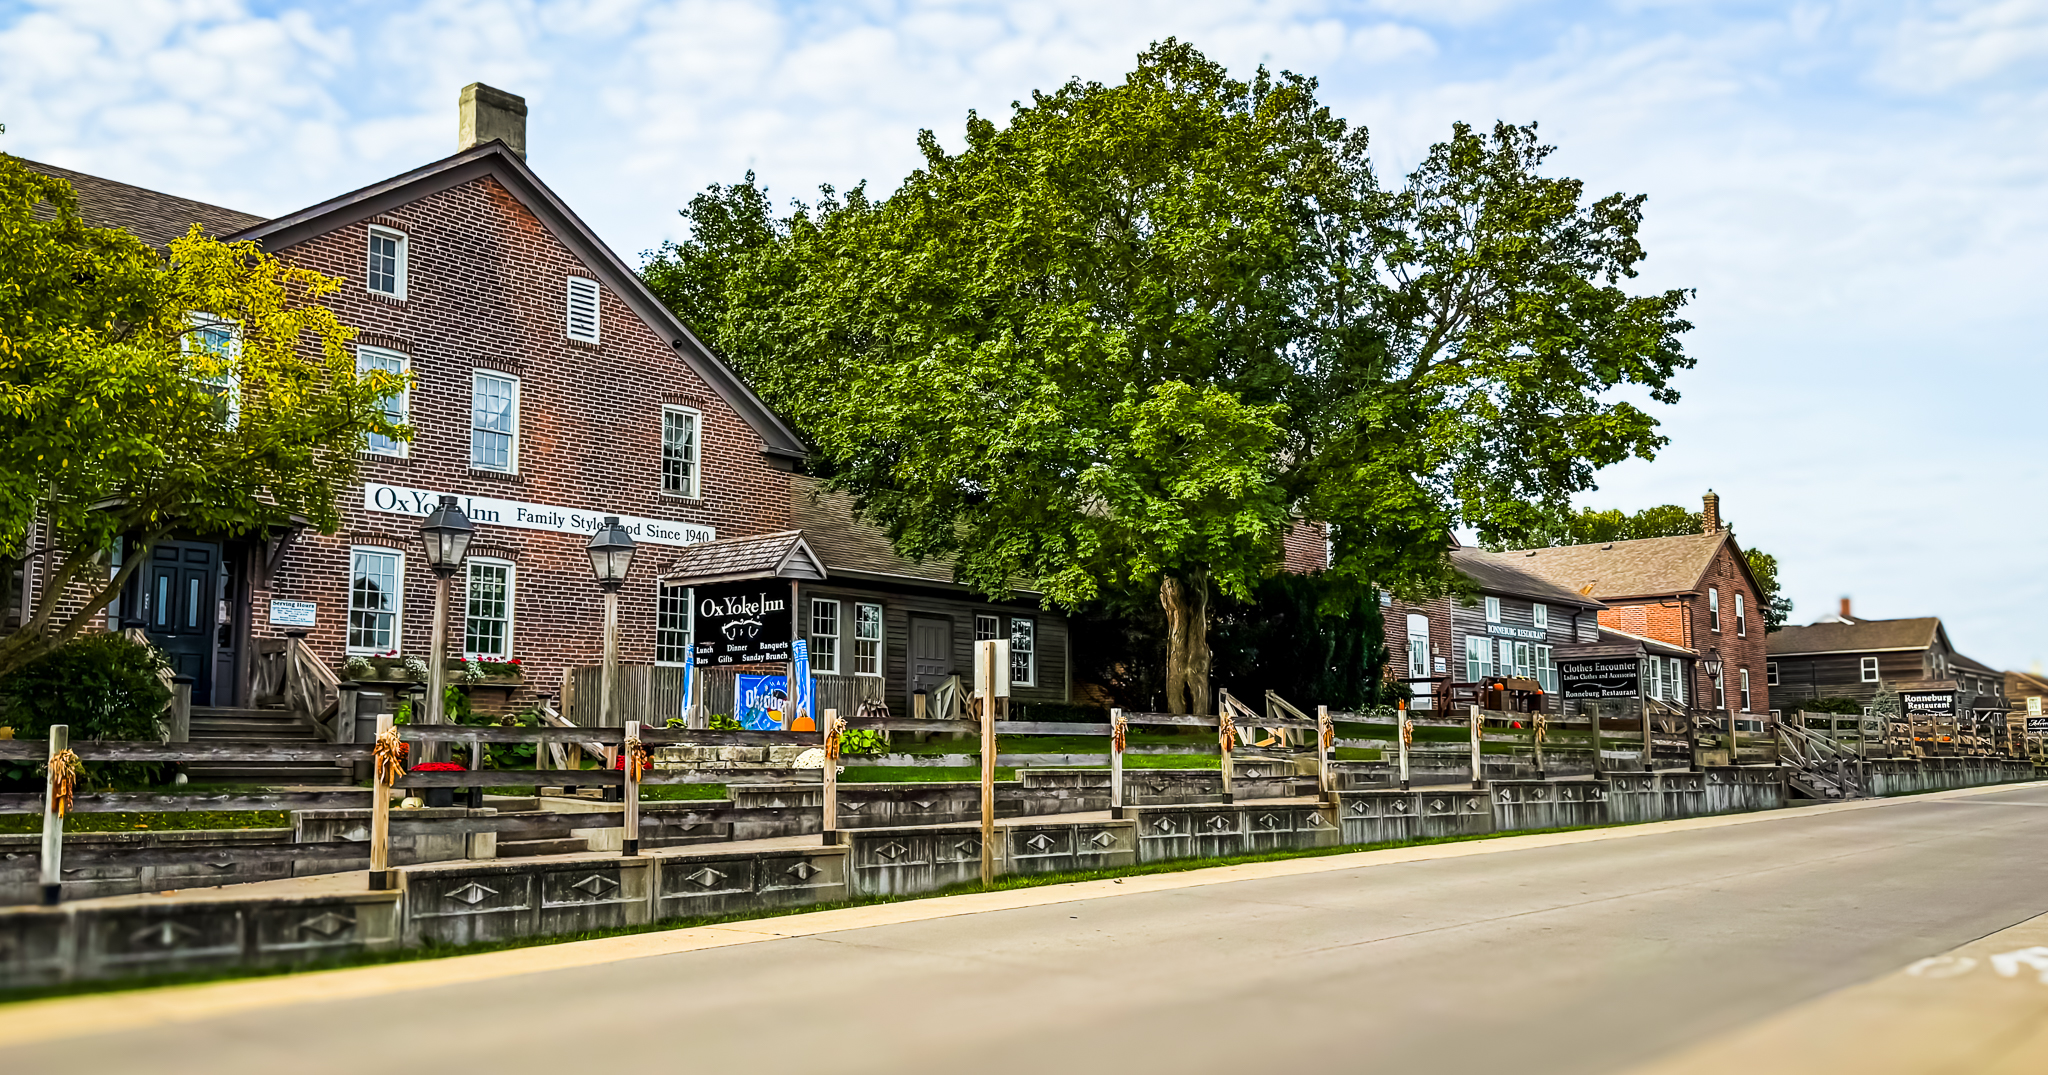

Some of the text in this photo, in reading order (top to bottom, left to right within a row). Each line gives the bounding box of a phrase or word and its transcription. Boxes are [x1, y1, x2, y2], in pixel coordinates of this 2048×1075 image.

[465, 497, 501, 522] Inn
[516, 507, 565, 528] Family
[646, 524, 681, 540] Since
[685, 529, 709, 543] 1940
[759, 592, 785, 615] Inn
[1487, 625, 1547, 640] RONNEBURG RESTAURANT
[696, 641, 788, 654] Lunch Dinner Banquets
[696, 651, 788, 665] Bars Gifts Sunday Brunch
[1563, 662, 1636, 673] Clothes Encounter
[1565, 689, 1637, 698] Ronneburg Restaurant
[1904, 693, 1953, 703] Ronneburg
